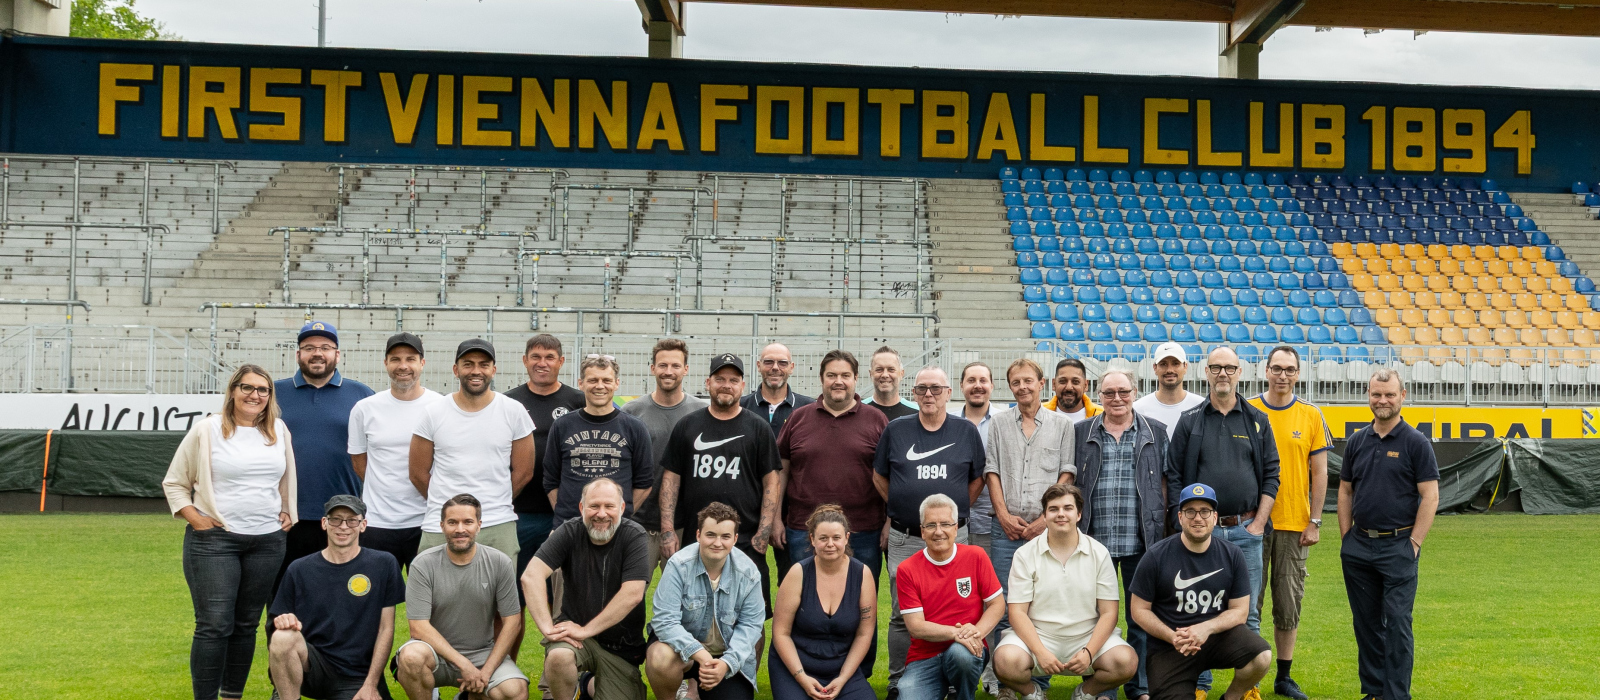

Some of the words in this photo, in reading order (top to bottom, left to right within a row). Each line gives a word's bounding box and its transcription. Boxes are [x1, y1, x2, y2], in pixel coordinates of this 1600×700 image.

[98, 63, 362, 142] FIRST
[379, 72, 684, 151] VIENNA
[700, 84, 1130, 163] FOOTBALL
[1143, 98, 1346, 169] CLUB
[1362, 106, 1536, 174] 1894
[564, 429, 628, 448] VINTAGE
[692, 453, 741, 480] 1894
[916, 464, 948, 480] 1894
[1175, 589, 1226, 615] 1894
